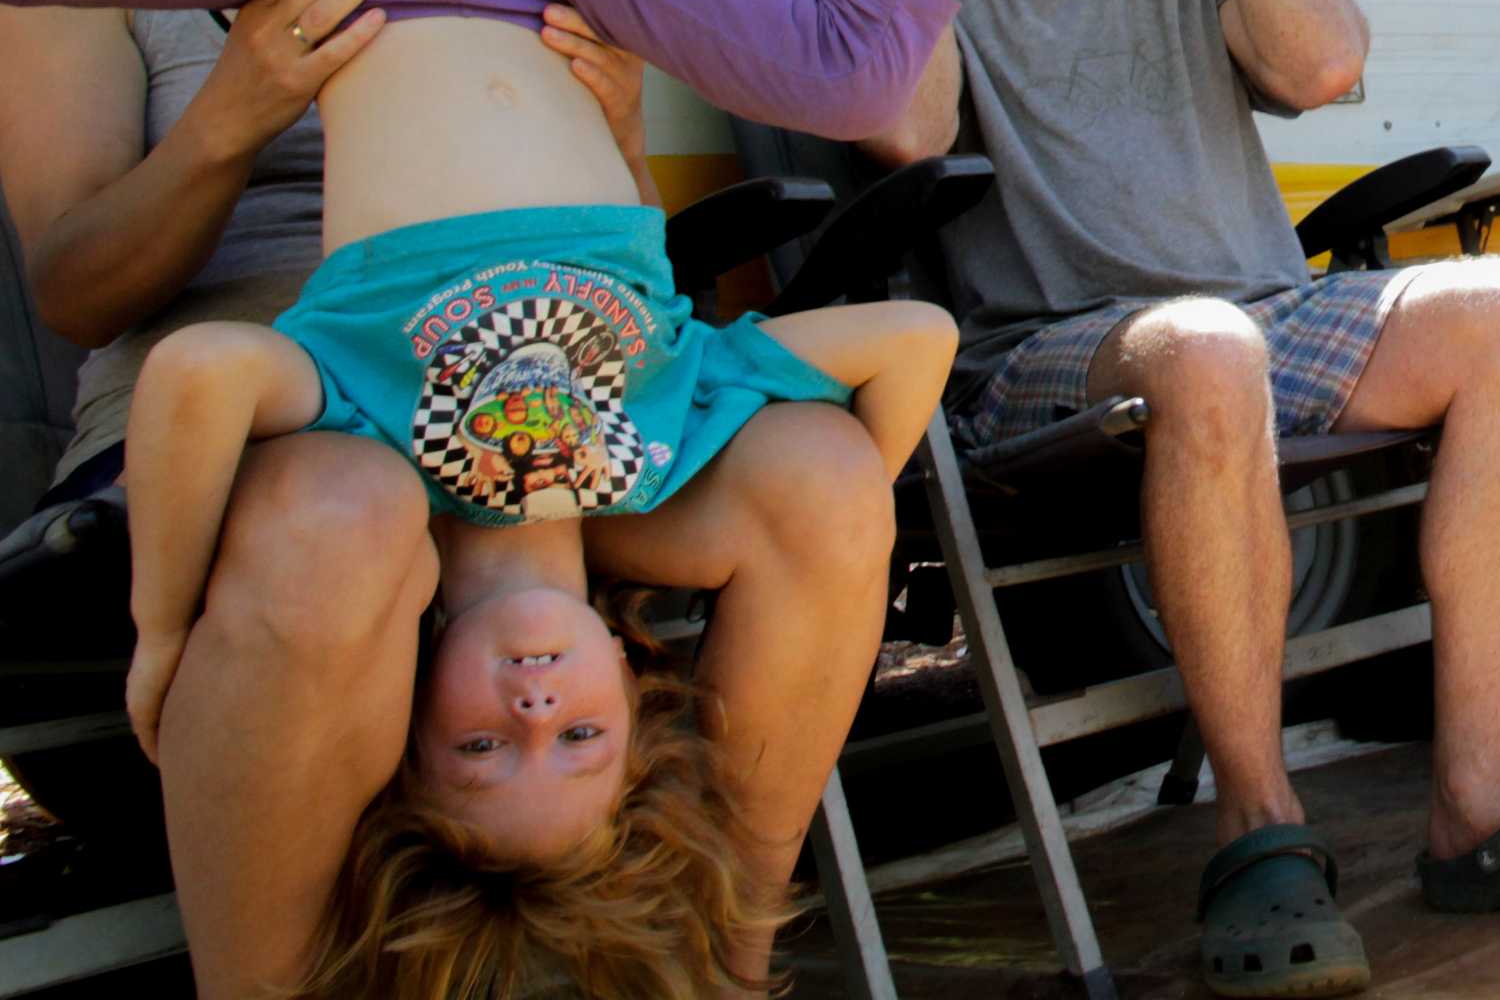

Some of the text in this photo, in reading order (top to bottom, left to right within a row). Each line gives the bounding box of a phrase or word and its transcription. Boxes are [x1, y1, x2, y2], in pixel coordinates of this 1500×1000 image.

[475, 259, 529, 282] Youth
[402, 279, 473, 335] Program
[410, 285, 497, 361] SOUP
